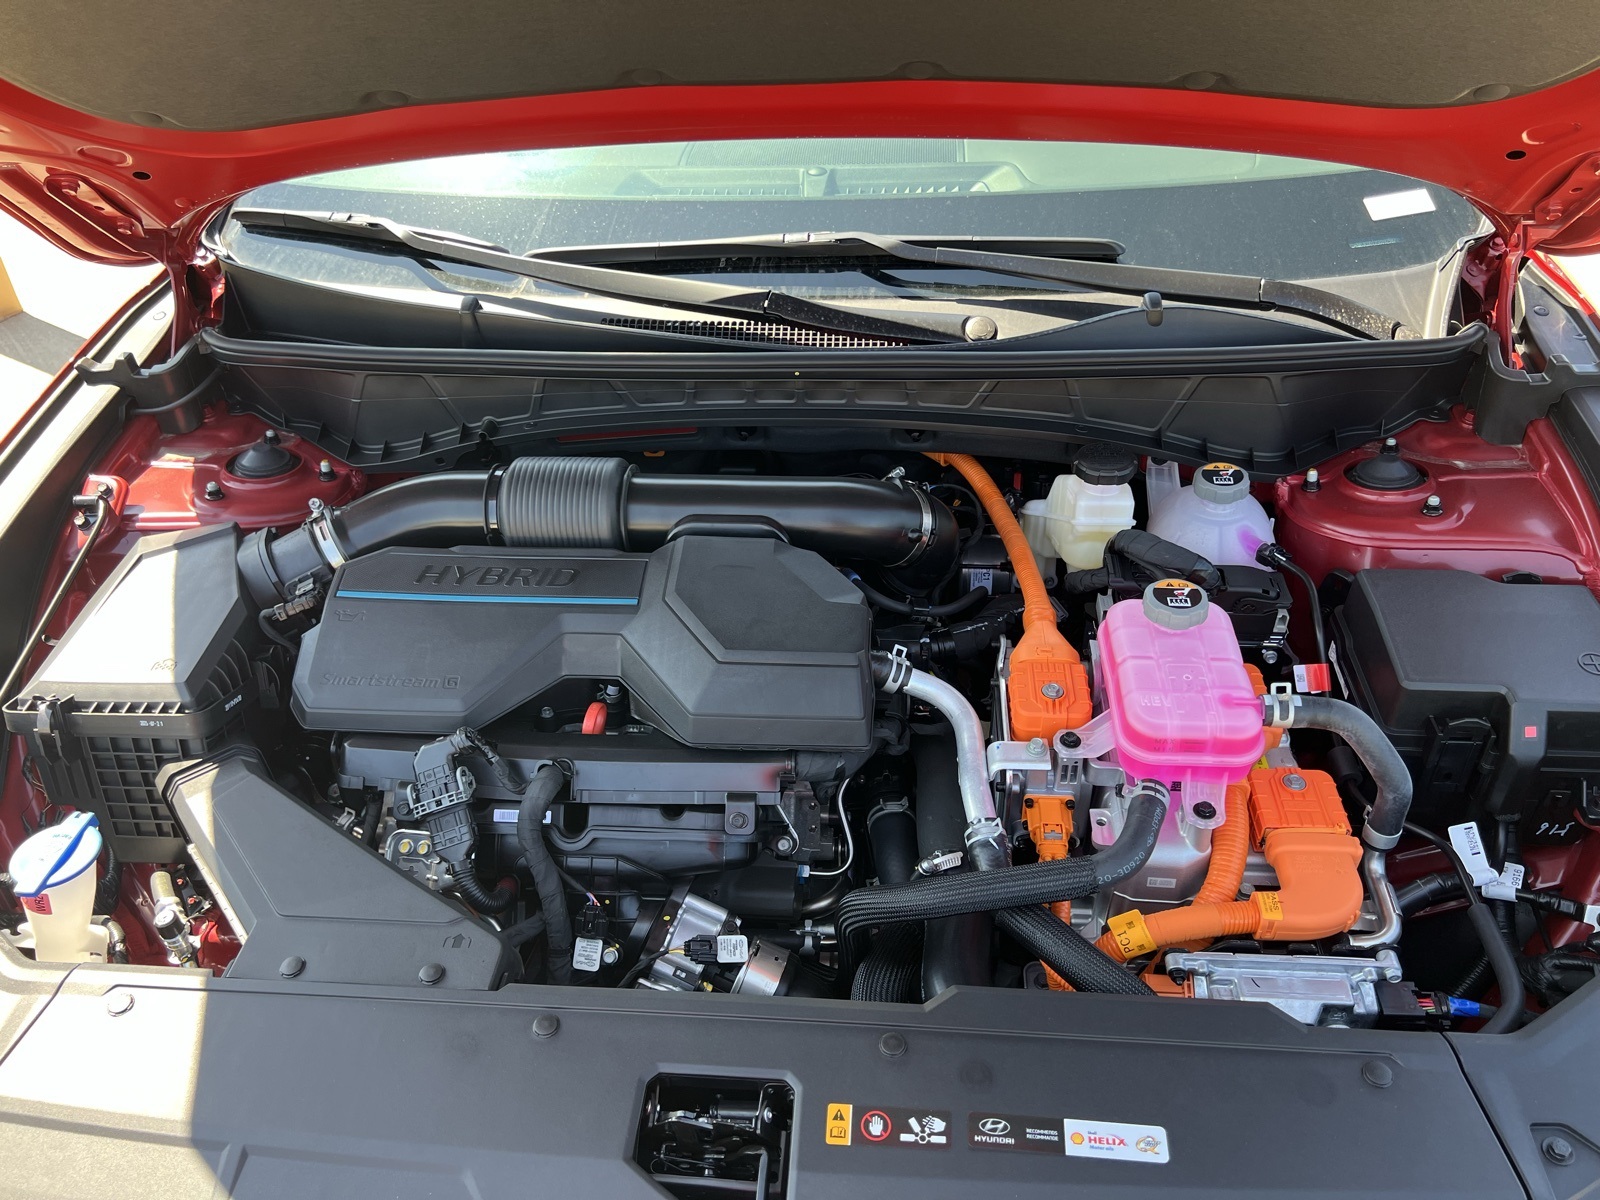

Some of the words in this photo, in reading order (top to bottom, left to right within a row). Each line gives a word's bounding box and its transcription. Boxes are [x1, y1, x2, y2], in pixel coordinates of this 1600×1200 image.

[413, 564, 581, 588] HYBRID
[320, 672, 440, 689] Smartstream
[1117, 930, 1135, 954] PC1
[974, 1134, 1015, 1145] HYUNDAI
[1087, 1136, 1128, 1147] HELIX
